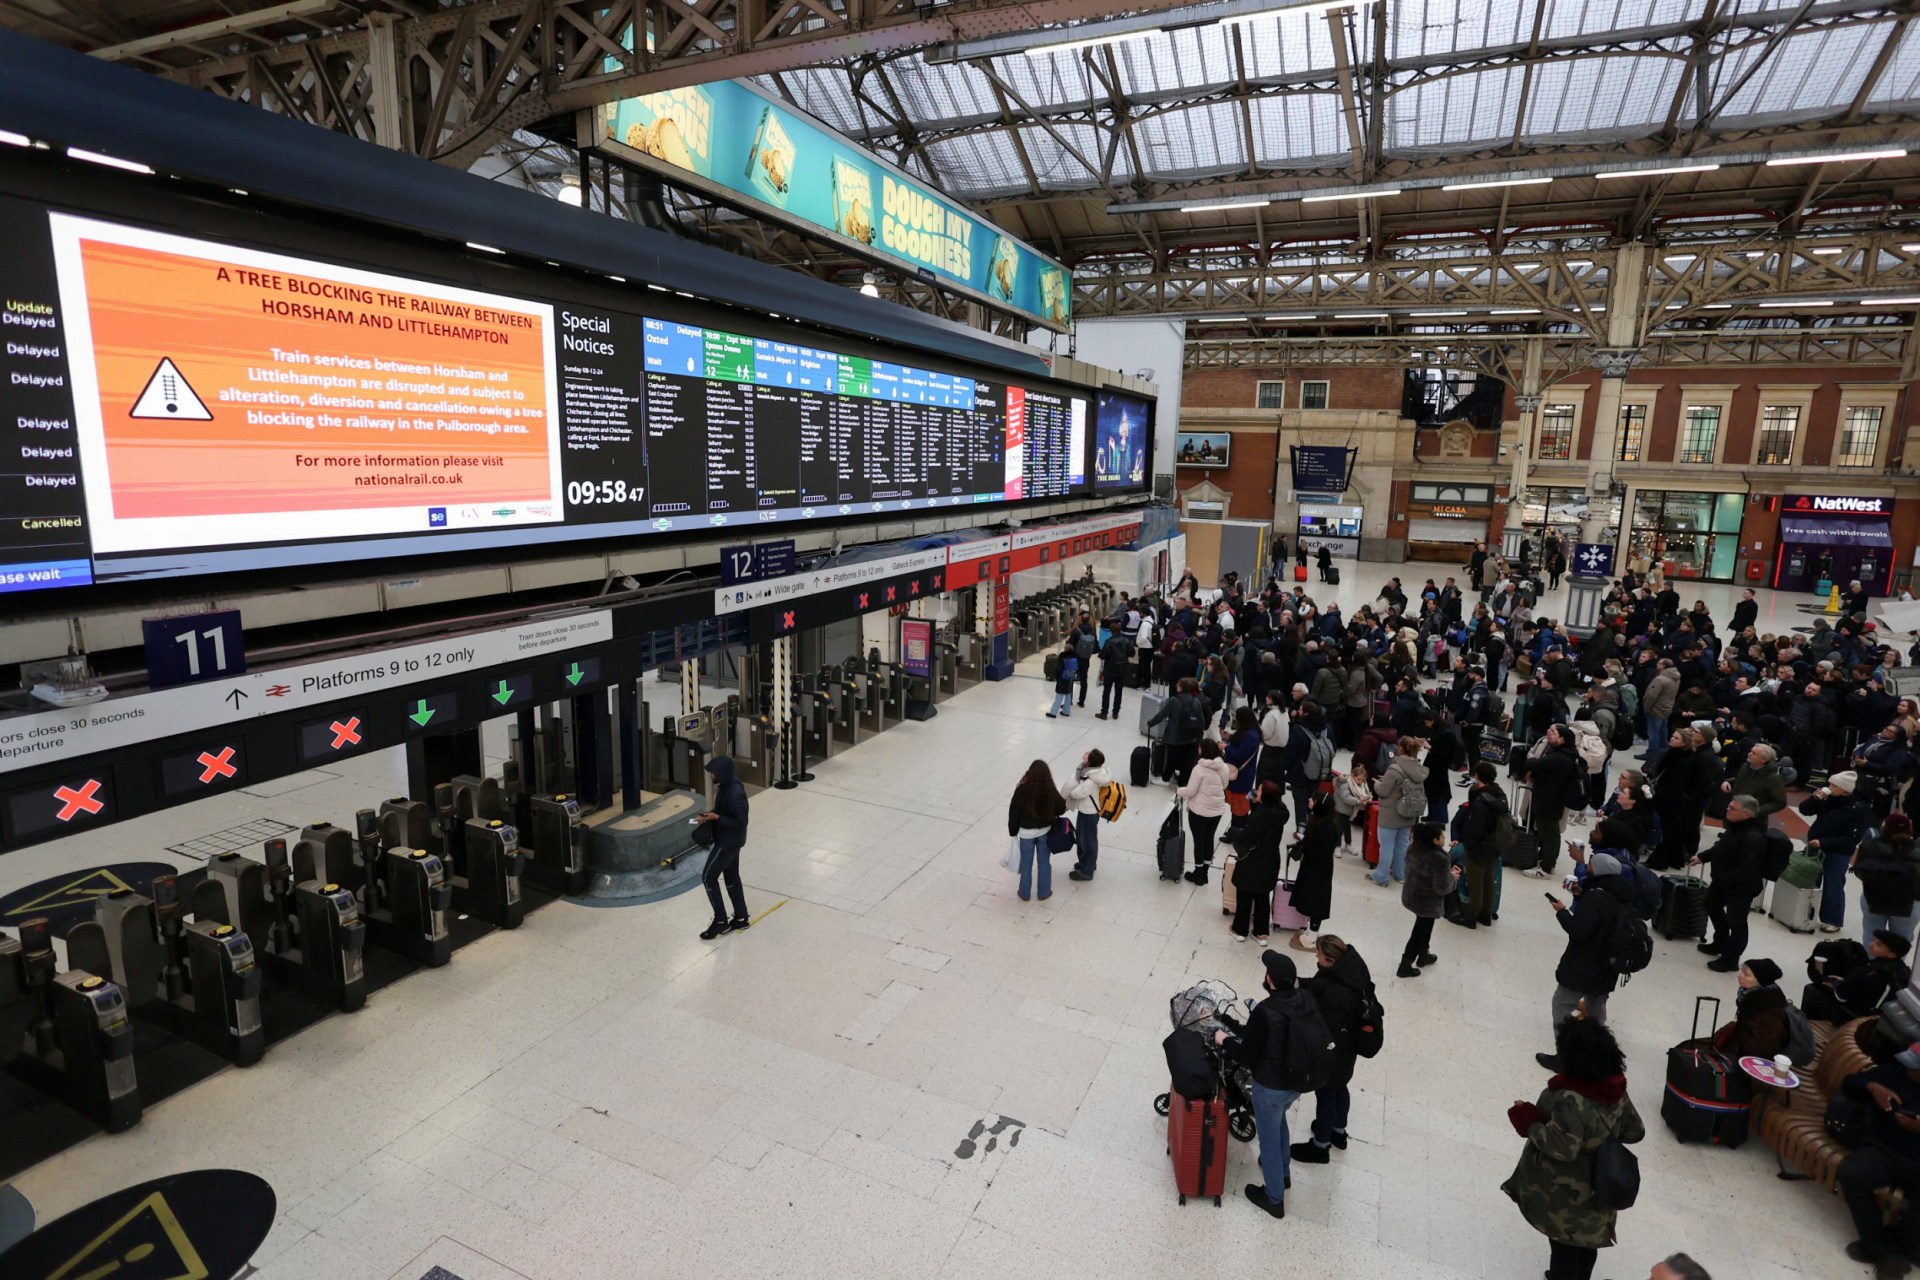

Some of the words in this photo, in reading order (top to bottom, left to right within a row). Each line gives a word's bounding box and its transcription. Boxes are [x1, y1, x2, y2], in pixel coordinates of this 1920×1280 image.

[882, 175, 945, 234] DOUGH
[946, 210, 972, 247] MY
[882, 214, 971, 280] GOODNESS
[217, 267, 231, 283] A
[235, 269, 282, 290] TREE
[287, 278, 373, 304] BLOCKING
[377, 293, 406, 309] THE
[411, 298, 471, 318] RAILWAY
[474, 308, 533, 328] BETWEEN
[6, 301, 53, 315] Update
[2, 313, 55, 328] Delayed
[261, 298, 354, 324] HORSHAM
[358, 313, 393, 329] AND
[397, 317, 509, 344] LITTLEHAMPTON
[562, 311, 610, 333] Special
[676, 325, 702, 337] Delayed
[563, 333, 615, 355] Notices
[646, 333, 669, 344] Oxted
[6, 343, 59, 358] Delayed
[705, 341, 724, 351] Epsom
[724, 344, 741, 352] Downs
[270, 348, 311, 364] Train
[313, 354, 373, 369] services
[374, 357, 431, 375] between
[433, 364, 485, 381] Horsham
[487, 371, 508, 383] and
[646, 356, 662, 366] Wait
[564, 364, 582, 374] Sunday
[582, 366, 603, 375] 08-12-24
[706, 366, 717, 375] 12
[10, 373, 63, 387] Delayed
[247, 367, 357, 389] Littlehampton
[360, 378, 383, 390] are
[385, 378, 445, 396] disrupted
[448, 385, 470, 396] and
[472, 386, 511, 401] subject
[513, 389, 524, 401] to
[564, 382, 593, 392] Engineering
[593, 384, 605, 392] work
[609, 387, 624, 395] taking
[219, 387, 305, 408] alteration,
[308, 392, 374, 409] diversion
[377, 398, 402, 411] and
[405, 401, 476, 415] cancellation
[478, 406, 512, 418] owing
[513, 408, 520, 417] a
[522, 407, 543, 418] tree
[565, 391, 578, 399] place
[579, 392, 599, 401] between
[600, 394, 631, 403] Littlehampton
[631, 396, 639, 404] and
[589, 402, 606, 410] Bognor
[606, 403, 618, 411] Regis
[593, 410, 609, 418] closing
[17, 417, 68, 431] Delayed
[247, 409, 315, 429] blocking
[317, 414, 342, 427] the
[345, 415, 395, 431] railway
[397, 416, 410, 429] in
[413, 418, 434, 430] the
[436, 419, 501, 434] Pulborough
[503, 423, 529, 434] area.
[566, 417, 582, 425] Buses
[590, 418, 608, 426] operate
[567, 425, 600, 434] Littlehampton
[600, 426, 609, 434] and
[567, 434, 583, 442] calling
[21, 446, 72, 459] Delayed
[568, 442, 585, 450] Bognor
[295, 454, 319, 467] For
[324, 456, 361, 467] more
[364, 454, 439, 467] information
[443, 455, 479, 469] please
[482, 454, 504, 466] visit
[25, 475, 76, 488] Delayed
[355, 472, 463, 487] nationalrail.co.uk
[567, 479, 628, 505] 09:58
[628, 486, 645, 502] 47
[1433, 505, 1444, 513] MI
[1445, 505, 1466, 514] CASA
[1813, 497, 1883, 512] NatWest
[21, 517, 81, 530] Cancelled
[431, 512, 444, 522] se
[1828, 529, 1888, 538] withdrawals
[1304, 540, 1344, 551] xchnge
[731, 551, 752, 578] 12
[892, 561, 909, 571] Gatwick
[909, 557, 925, 569] Express
[28, 568, 61, 583] wait
[833, 568, 857, 583] Platforms
[861, 568, 868, 577] to
[868, 567, 874, 576] 12
[874, 565, 885, 576] only
[774, 584, 791, 595] Wide
[791, 582, 805, 594] gate
[518, 633, 535, 642] Train
[535, 630, 552, 639] doors
[553, 627, 569, 636] close
[577, 621, 600, 630] seconds
[175, 625, 227, 676] 11
[518, 642, 539, 651] before
[539, 636, 567, 647] departure
[302, 667, 385, 693] Platforms
[389, 660, 400, 675] 9
[404, 658, 419, 672] to
[424, 652, 442, 668] 12
[446, 647, 476, 664] only
[28, 723, 66, 738] close
[70, 717, 88, 732] 30
[91, 708, 146, 726] seconds
